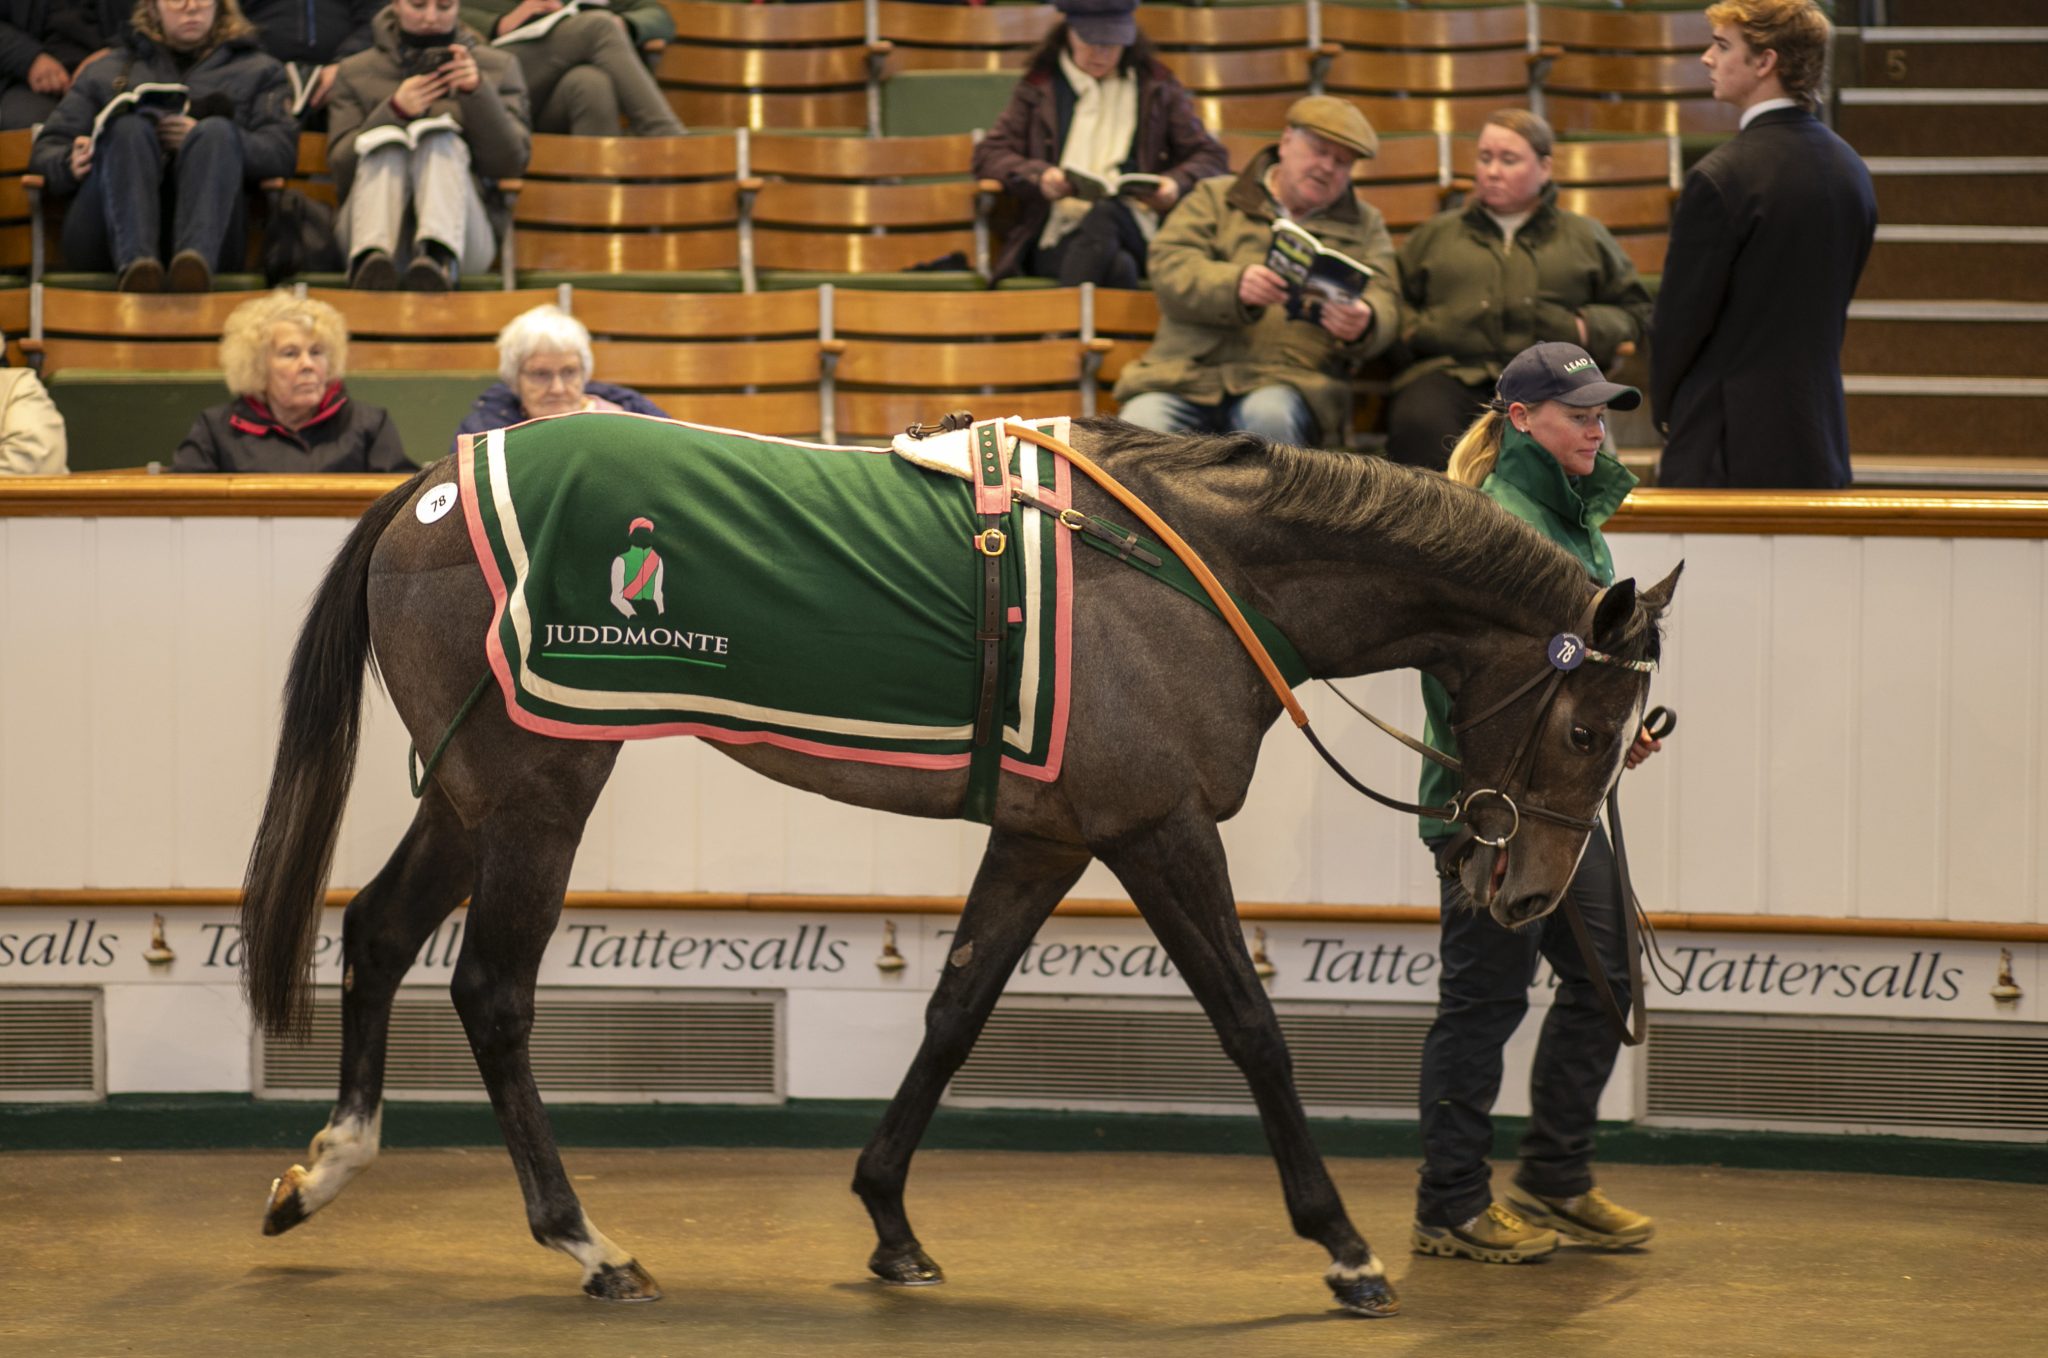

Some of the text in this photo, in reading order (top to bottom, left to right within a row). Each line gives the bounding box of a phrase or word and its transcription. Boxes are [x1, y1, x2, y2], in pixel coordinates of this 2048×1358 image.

[1887, 49, 1907, 80] 5
[1563, 357, 1588, 372] LEAD
[430, 494, 447, 512] 78
[544, 624, 729, 655] JUDDMONTE
[1556, 640, 1576, 663] 78
[566, 923, 849, 973] Tattersalls
[1674, 946, 1964, 1001] Tattersalls
